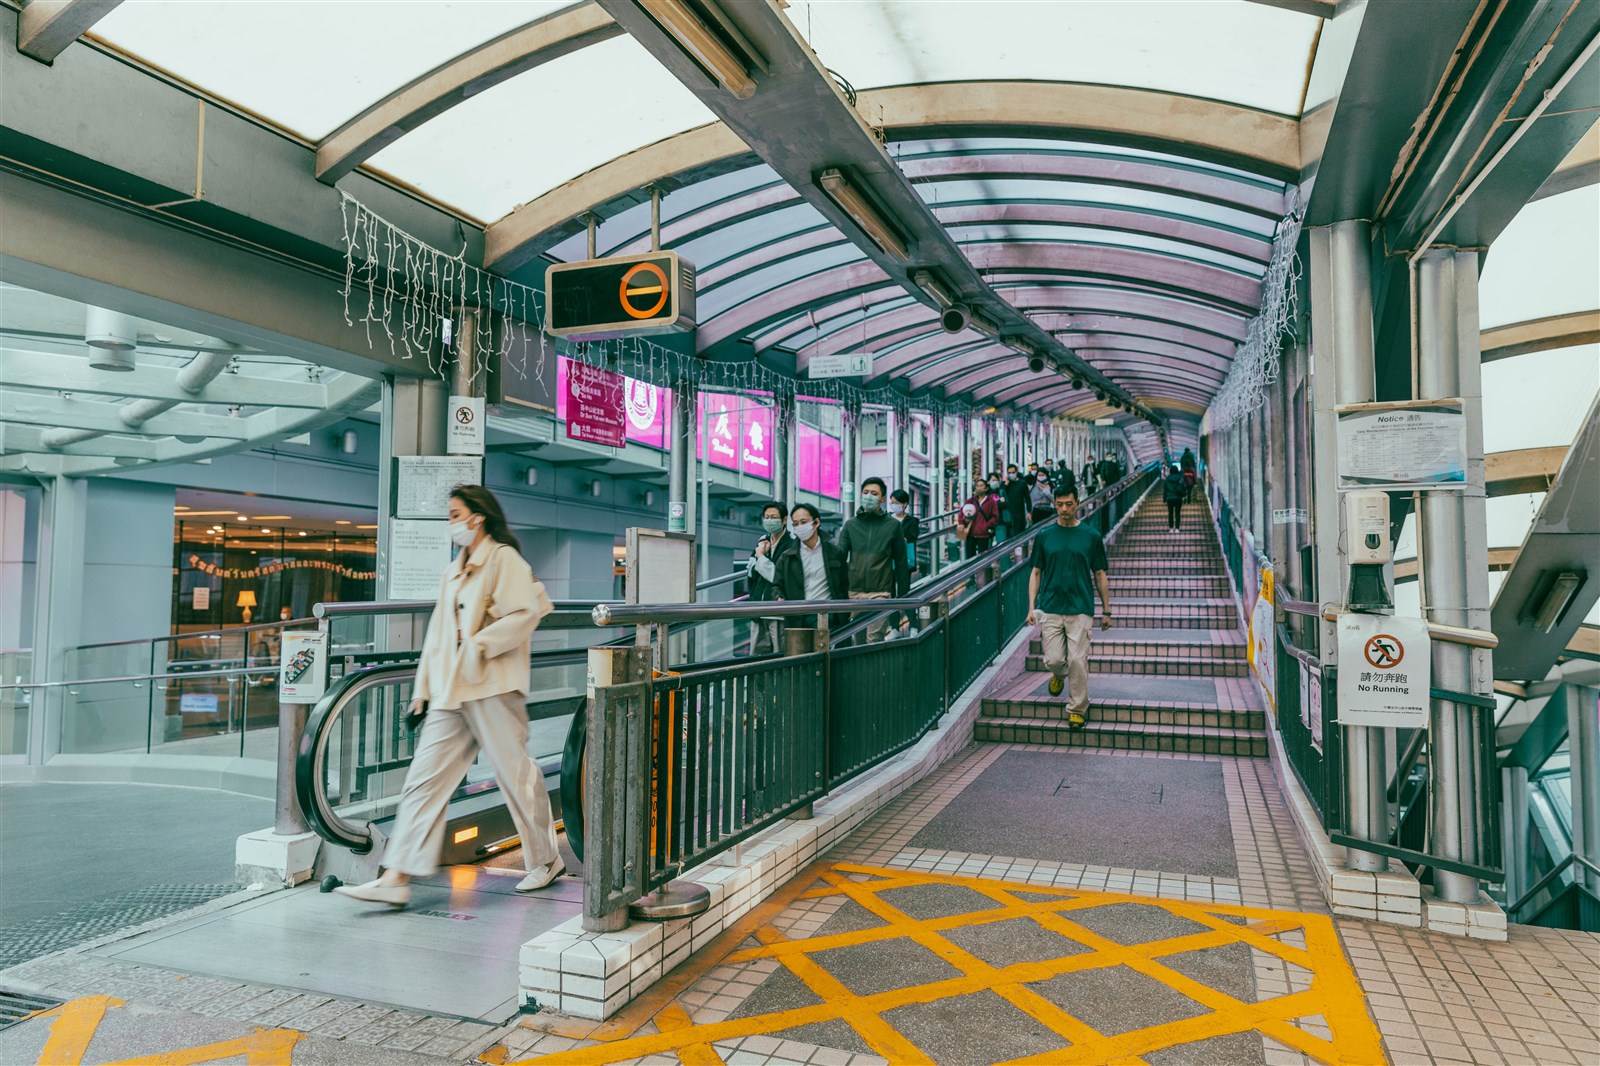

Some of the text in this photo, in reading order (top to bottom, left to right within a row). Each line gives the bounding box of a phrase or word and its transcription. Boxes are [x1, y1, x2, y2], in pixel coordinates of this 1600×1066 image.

[1377, 415, 1404, 423] Notice
[1360, 672, 1408, 684] 請勿奔跑
[1358, 684, 1409, 694] No Running
